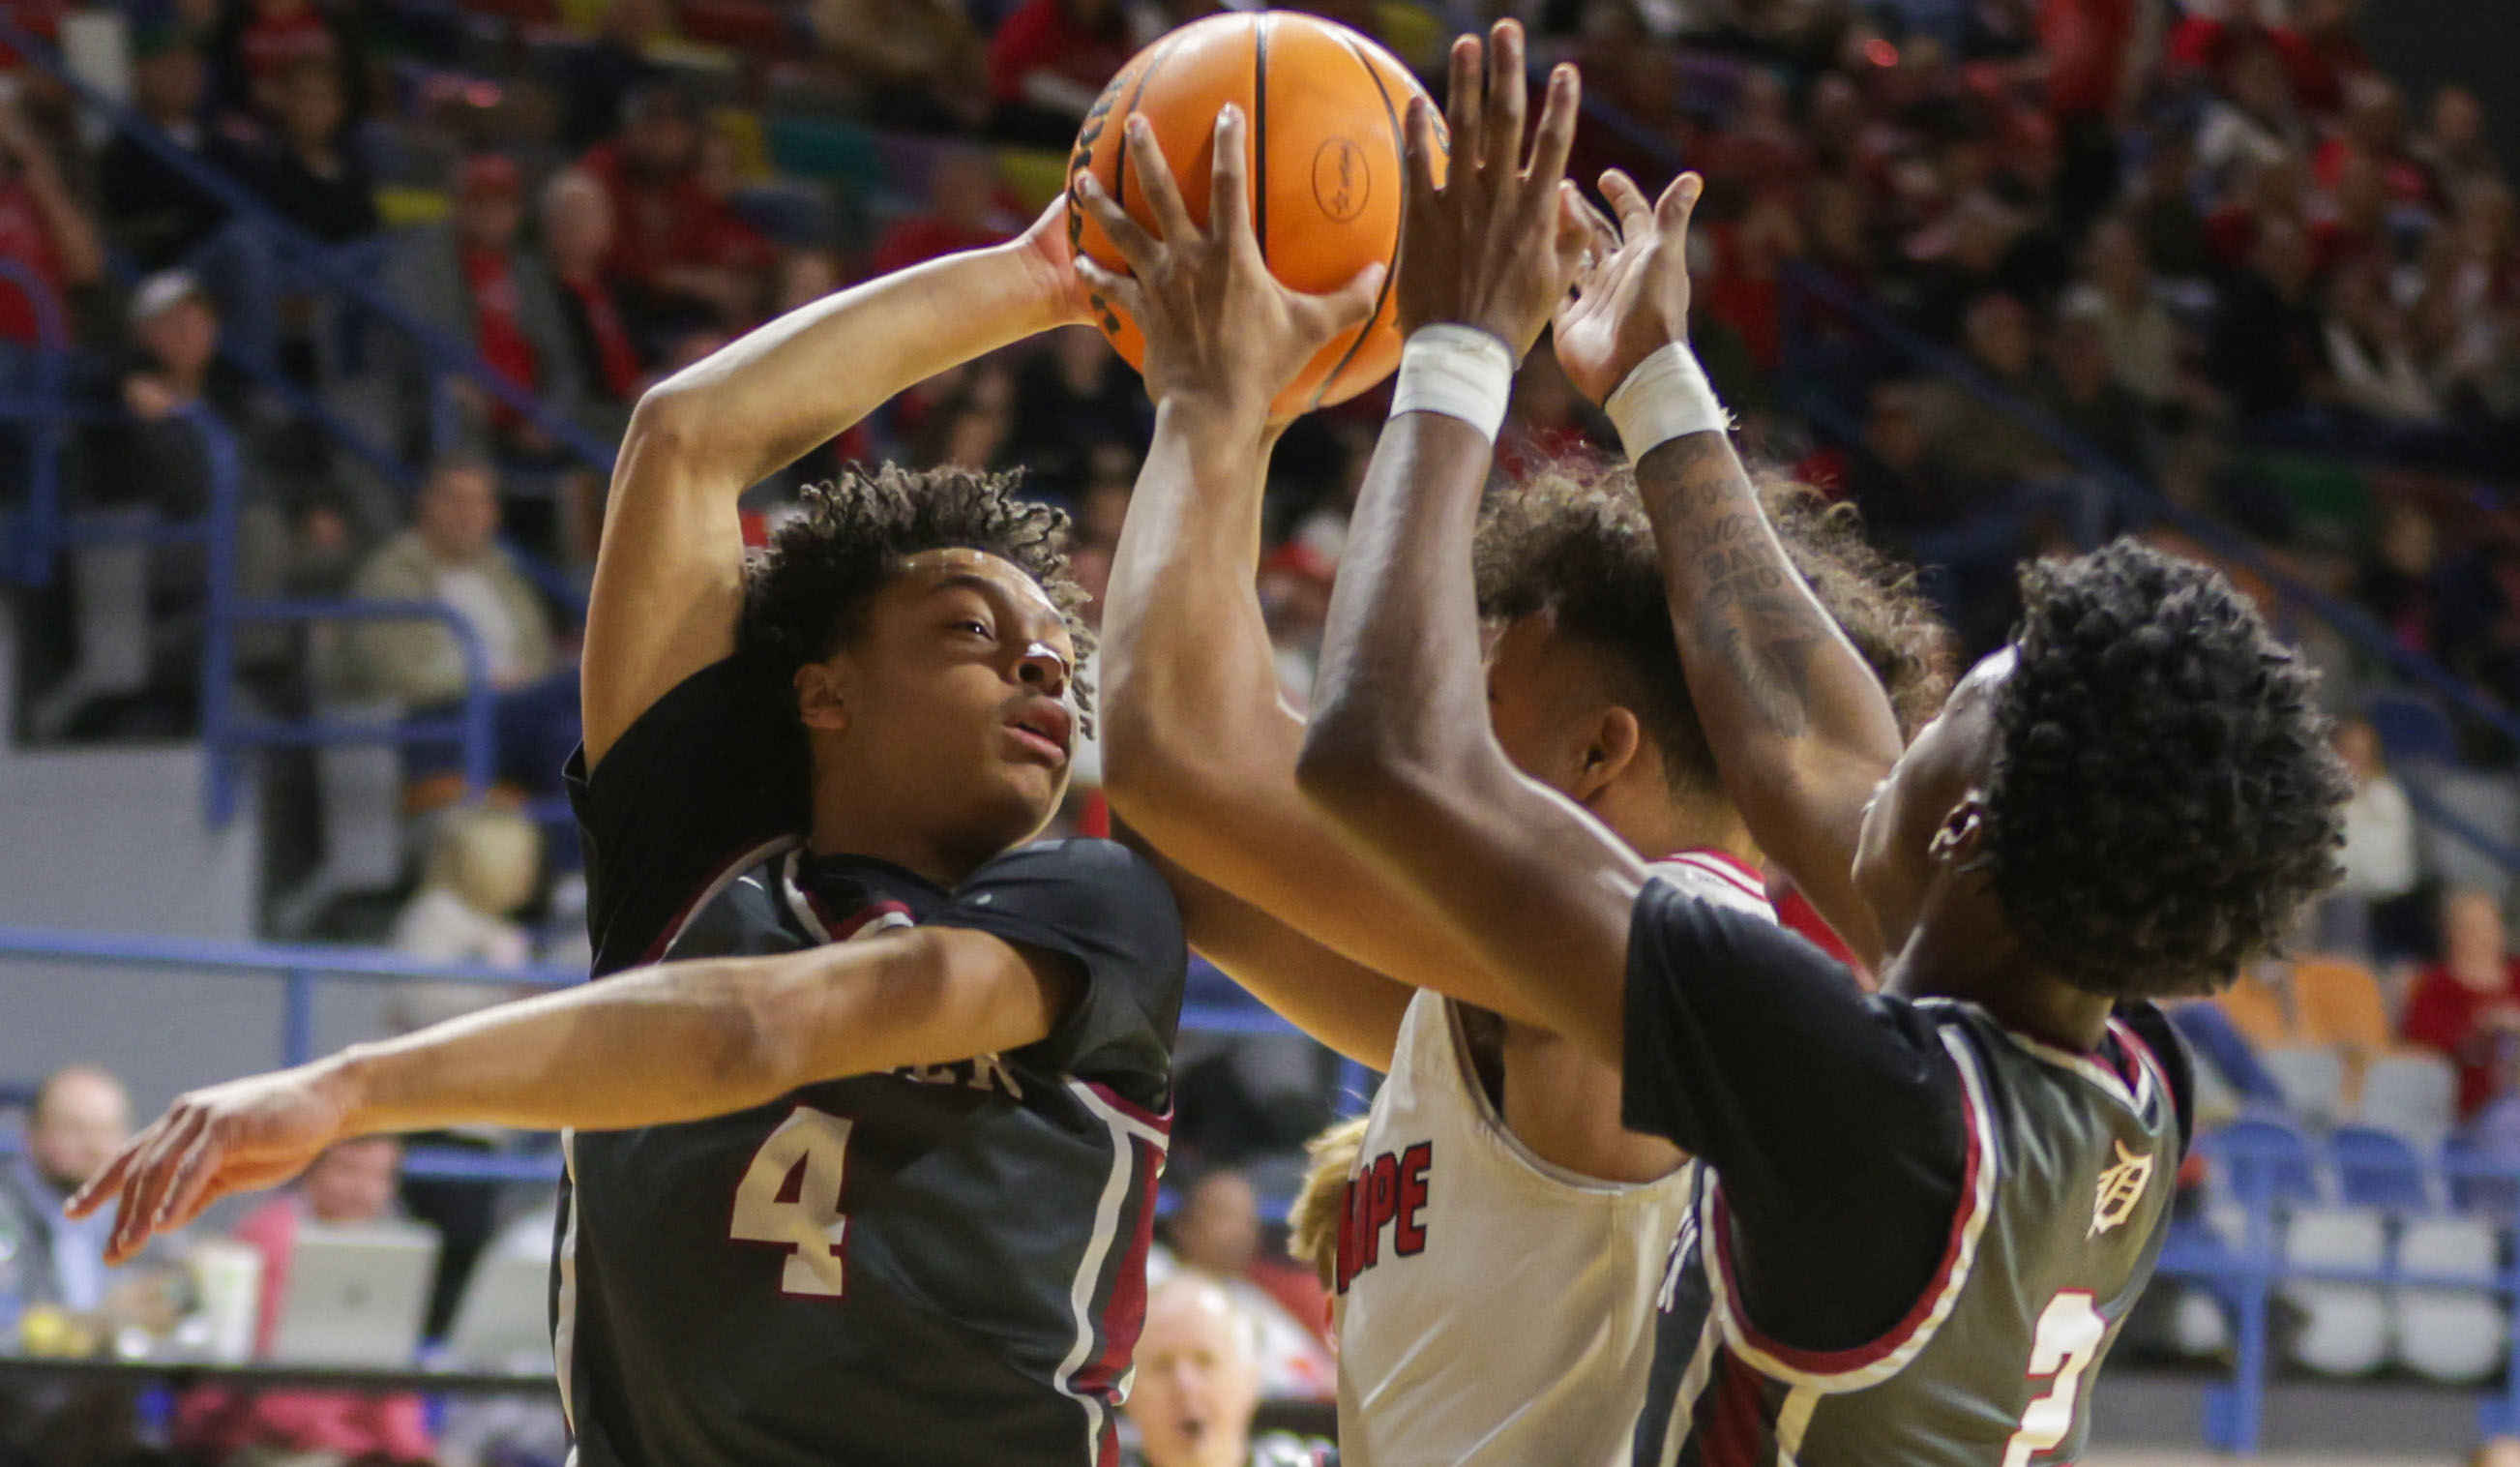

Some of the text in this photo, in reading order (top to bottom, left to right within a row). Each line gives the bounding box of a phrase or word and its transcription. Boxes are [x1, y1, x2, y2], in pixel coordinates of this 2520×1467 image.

[728, 1104, 855, 1298] 4
[2086, 1139, 2153, 1240] D
[2001, 1289, 2109, 1467] 2
